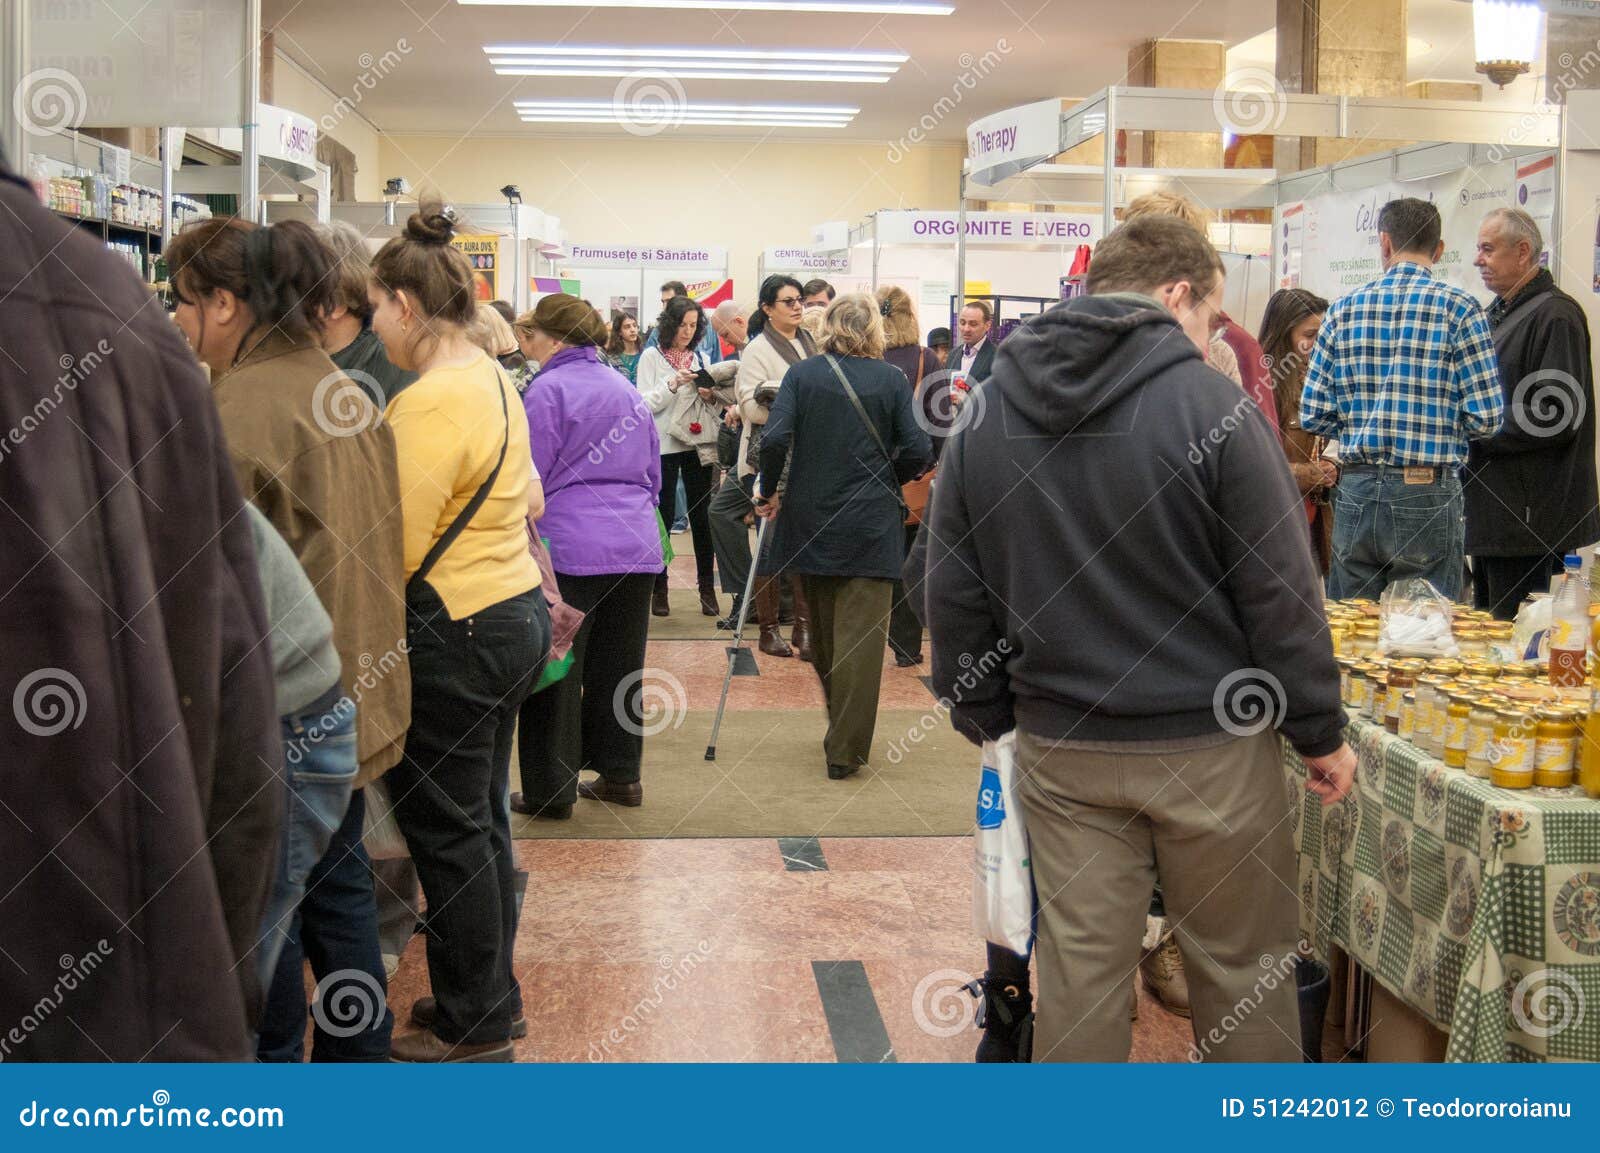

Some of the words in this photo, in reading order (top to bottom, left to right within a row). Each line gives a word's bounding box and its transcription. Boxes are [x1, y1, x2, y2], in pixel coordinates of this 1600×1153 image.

[976, 126, 1017, 154] Therapy
[913, 220, 1012, 236] ORGONITE
[1023, 221, 1091, 238] ELVERO
[775, 250, 810, 258] CENTRUL
